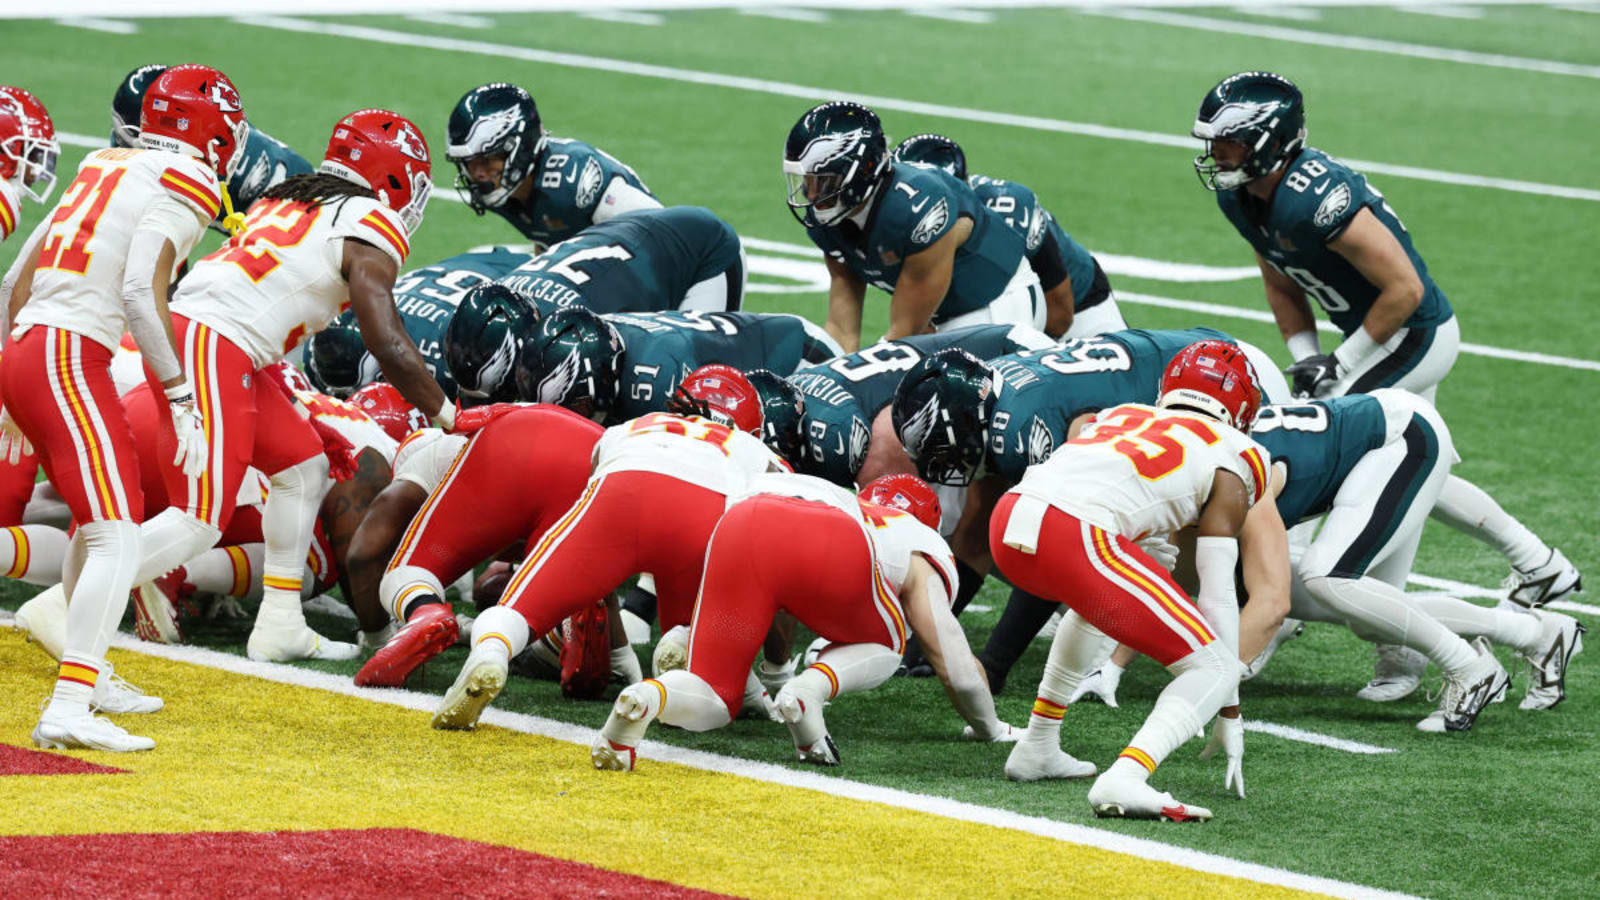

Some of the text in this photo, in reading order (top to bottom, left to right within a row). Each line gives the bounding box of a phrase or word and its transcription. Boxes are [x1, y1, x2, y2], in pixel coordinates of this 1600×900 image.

[162, 141, 180, 150] LOVE
[541, 153, 570, 188] 89
[1286, 159, 1328, 193] 88
[894, 181, 919, 200] 1
[35, 165, 128, 276] 21
[393, 294, 449, 323] JOHN
[631, 364, 661, 401] 51
[991, 411, 1011, 455] 68
[1066, 406, 1222, 482] 35
